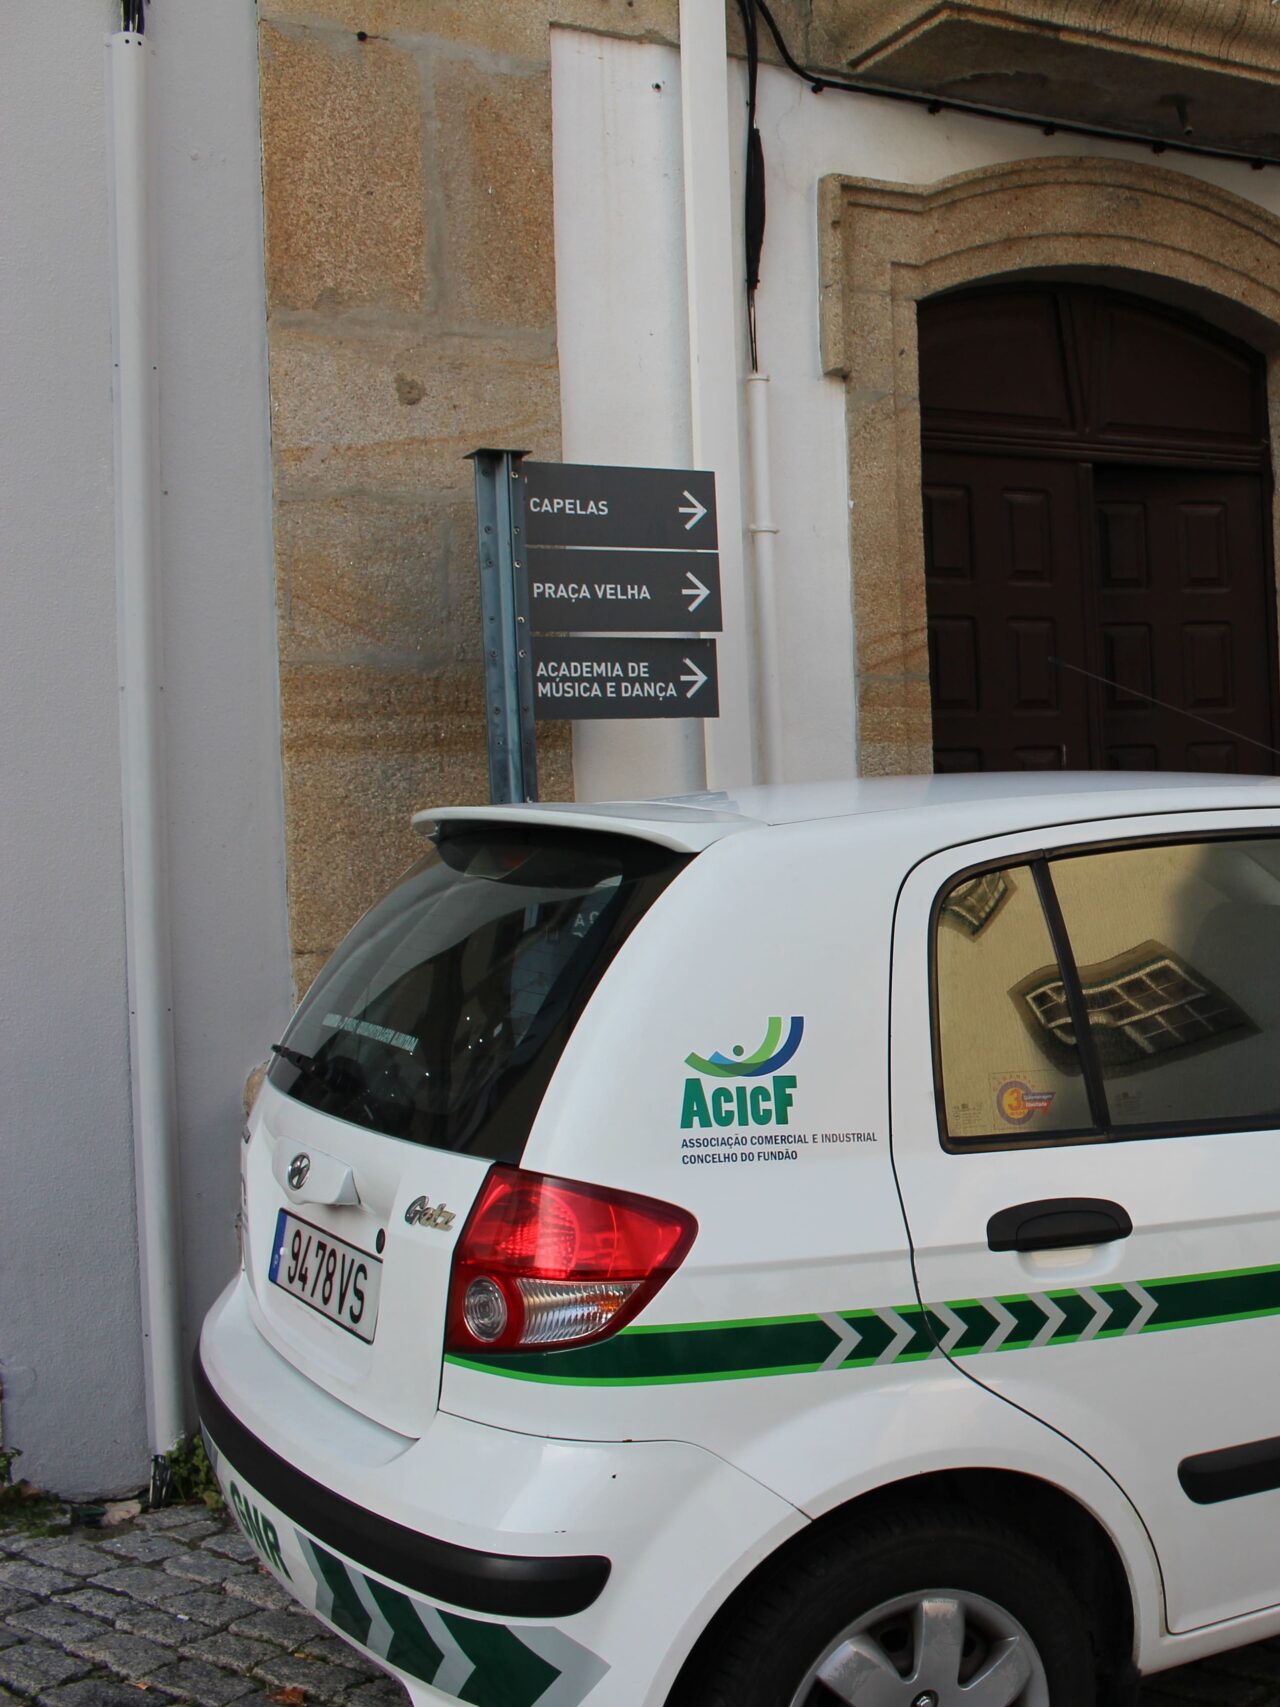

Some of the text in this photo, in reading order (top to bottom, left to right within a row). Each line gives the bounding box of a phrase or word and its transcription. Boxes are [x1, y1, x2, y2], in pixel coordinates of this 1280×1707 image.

[529, 498, 609, 516] CAPELAS
[532, 583, 651, 602] PRAÇA VELHA
[536, 662, 649, 678] ACADEMIA DE
[537, 677, 677, 701] MÚSICA E DANÇA
[680, 1075, 797, 1129] ACICF
[681, 1132, 877, 1149] ASSOCIAÇÃO COMERCIAL E INDUSTRIAL
[682, 1149, 798, 1165] CONCELHO DO FUNDÃO
[405, 1195, 456, 1231] Getz
[229, 1480, 295, 1584] GNR
